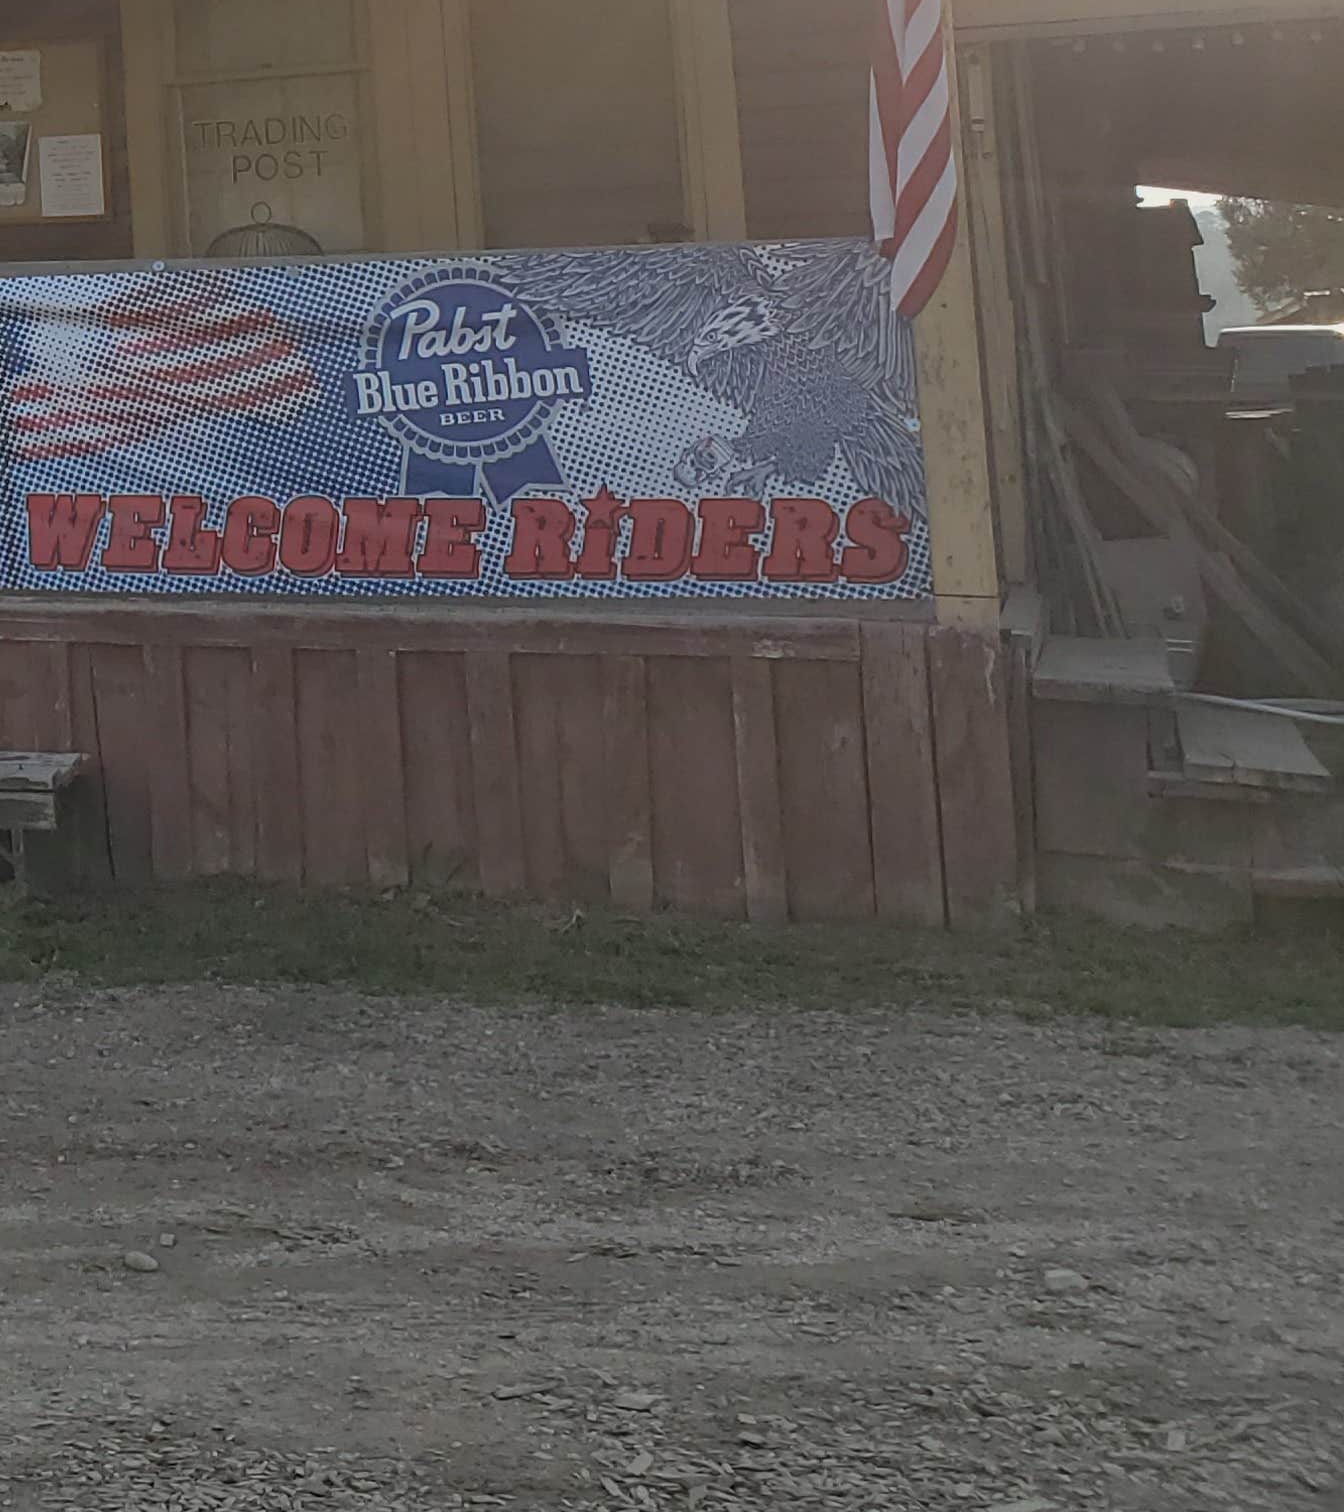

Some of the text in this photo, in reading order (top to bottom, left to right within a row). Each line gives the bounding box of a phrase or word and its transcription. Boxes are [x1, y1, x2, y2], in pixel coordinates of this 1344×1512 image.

[192, 113, 348, 148] TRADING
[231, 149, 328, 185] POST
[390, 299, 517, 360] Pabst
[353, 358, 584, 414] Blue Ribbon
[440, 408, 506, 426] BEER
[26, 493, 486, 580] WELCOME
